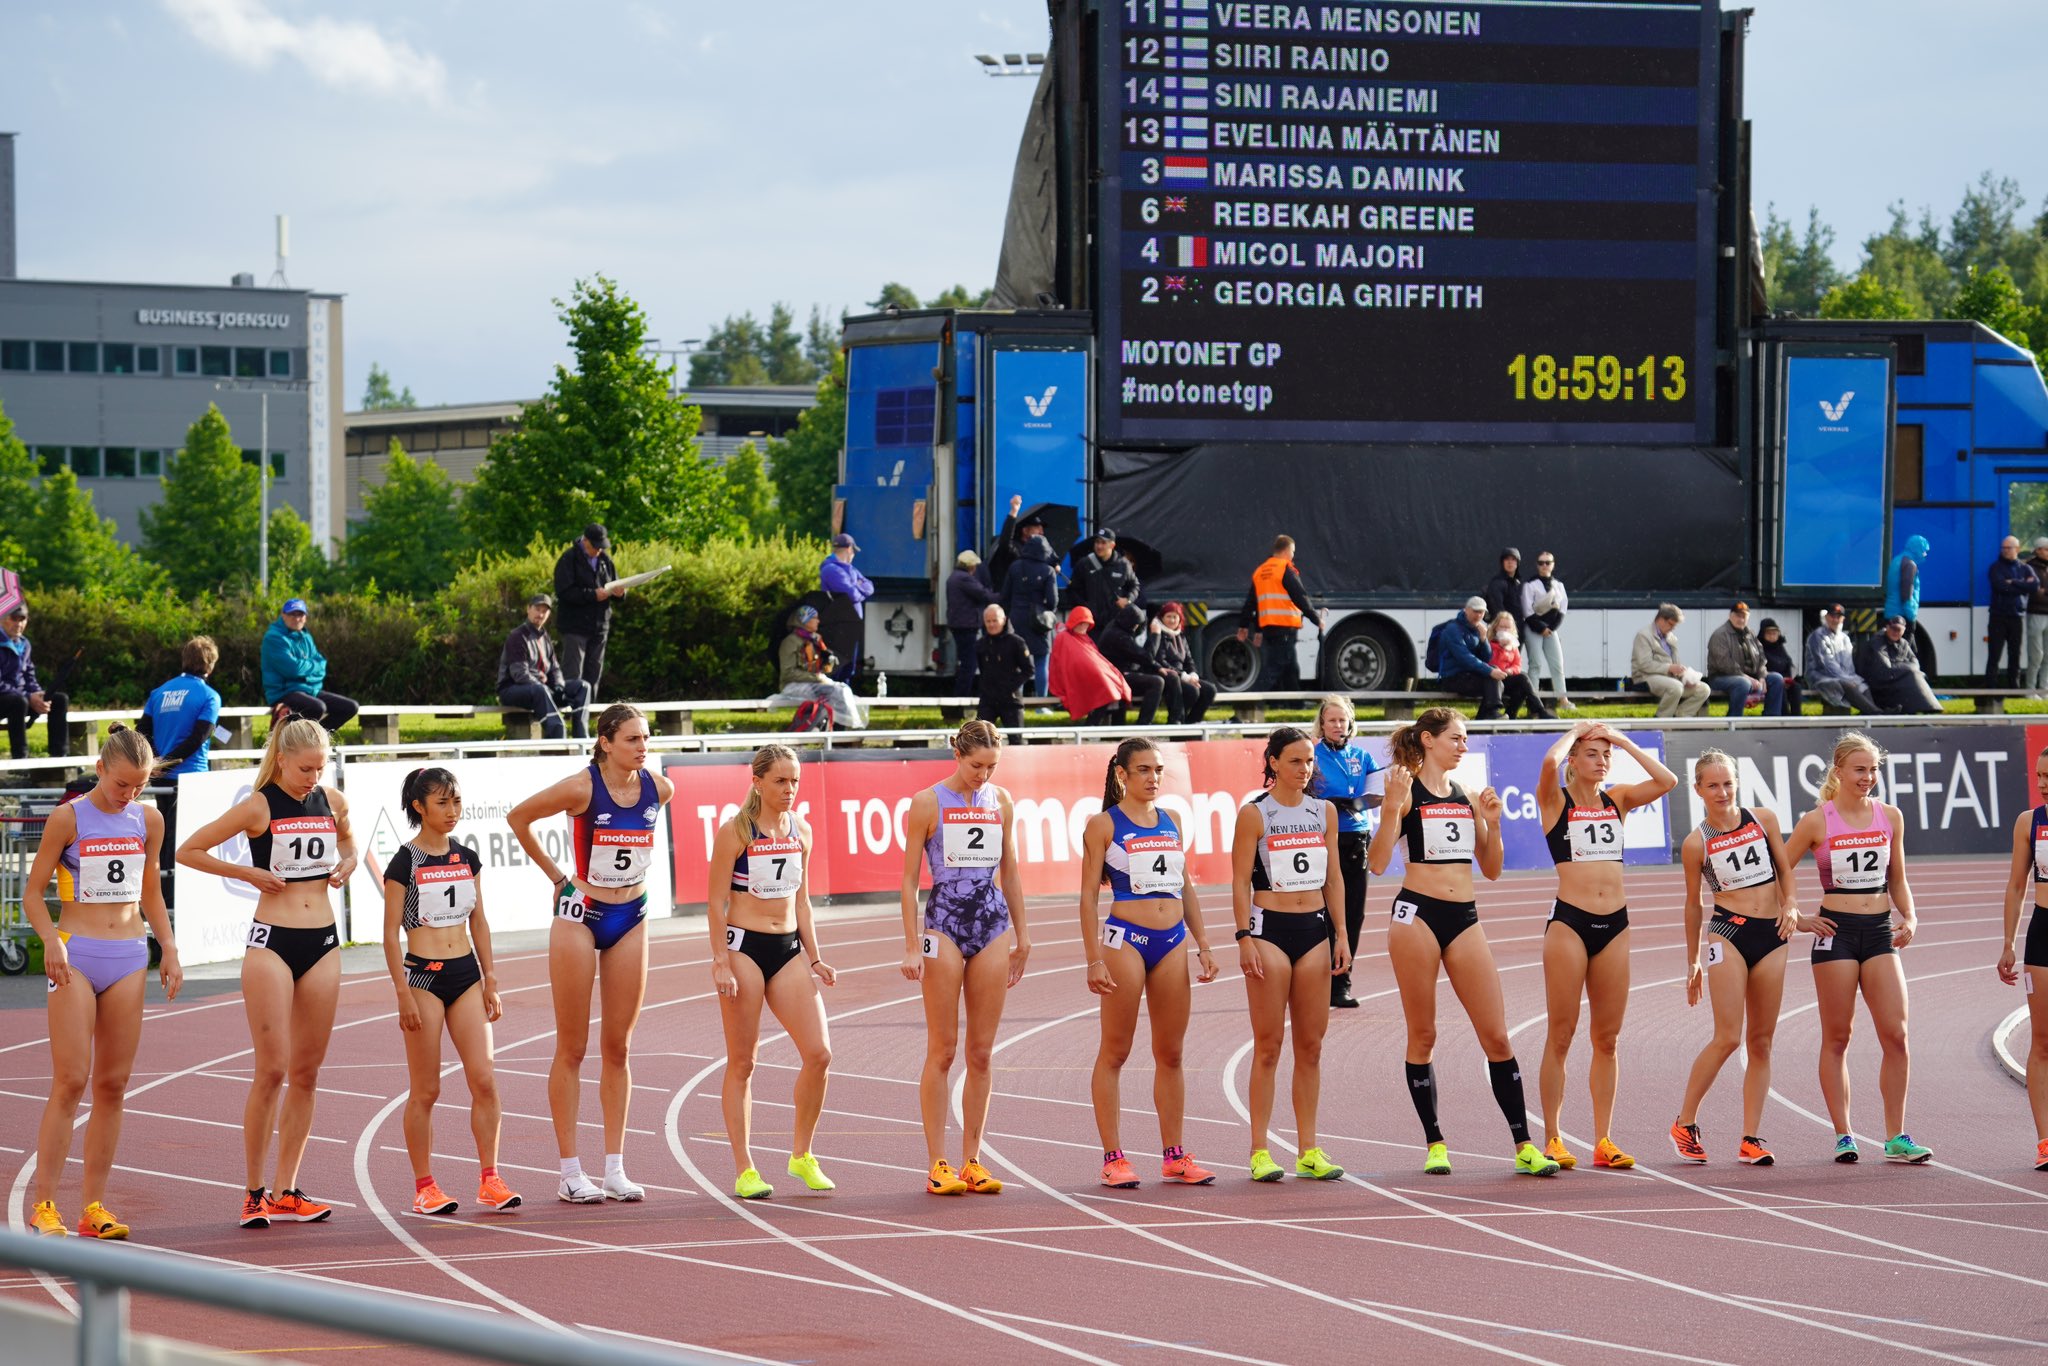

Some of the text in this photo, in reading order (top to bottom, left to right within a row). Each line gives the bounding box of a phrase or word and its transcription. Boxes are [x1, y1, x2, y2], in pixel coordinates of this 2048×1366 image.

[1125, 0, 1481, 36] 11 VEERA MENSONEN
[1125, 37, 1390, 72] 12 SIIRI RAINIO
[1125, 77, 1438, 113] 14 SINI RAJANIEMI
[1125, 118, 1501, 153] 13 EVELIINA MÄÄTTÄNEN
[1141, 158, 1465, 192] 3 MARISSA DAMINK
[1141, 198, 1475, 231] 6 REBEKAH GREENE
[1141, 238, 1425, 269] 4 MICOL MAJORI
[1141, 277, 1483, 309] 2 GEORGIA GRIFFITH
[139, 309, 290, 329] BUSINESS JOENSUU
[1122, 340, 1281, 368] MOTONET GP
[1122, 354, 1687, 411] #motonetgp 18:59:13
[949, 812, 997, 820] motonet
[1573, 809, 1617, 818] motonet
[277, 820, 330, 831] motonet
[1270, 824, 1321, 834] NEW ZEALAND
[1445, 822, 1461, 842] 3
[1584, 823, 1615, 844] 13
[86, 841, 140, 852] motonet
[289, 837, 325, 860] 10
[600, 834, 650, 843] motonet
[968, 828, 984, 849] 2
[1131, 840, 1178, 849] motonet
[1273, 836, 1322, 847] motonet
[1711, 829, 1758, 850] motonet
[1835, 835, 1883, 846] motonet
[614, 849, 631, 870] 5
[772, 858, 786, 880] 7
[1152, 855, 1167, 875] 4
[1293, 852, 1310, 873] 6
[1726, 846, 1760, 872] 14
[1846, 851, 1878, 872] 12
[107, 859, 125, 883] 8
[422, 868, 469, 879] motonet
[444, 885, 455, 908] 1
[561, 900, 583, 918] 10
[1398, 905, 1408, 918] 5
[1250, 917, 1255, 931] 6
[249, 926, 268, 944] 12
[728, 931, 735, 945] 9
[1109, 929, 1117, 943] 7
[924, 938, 931, 953] 8
[1709, 948, 1716, 961] 3
